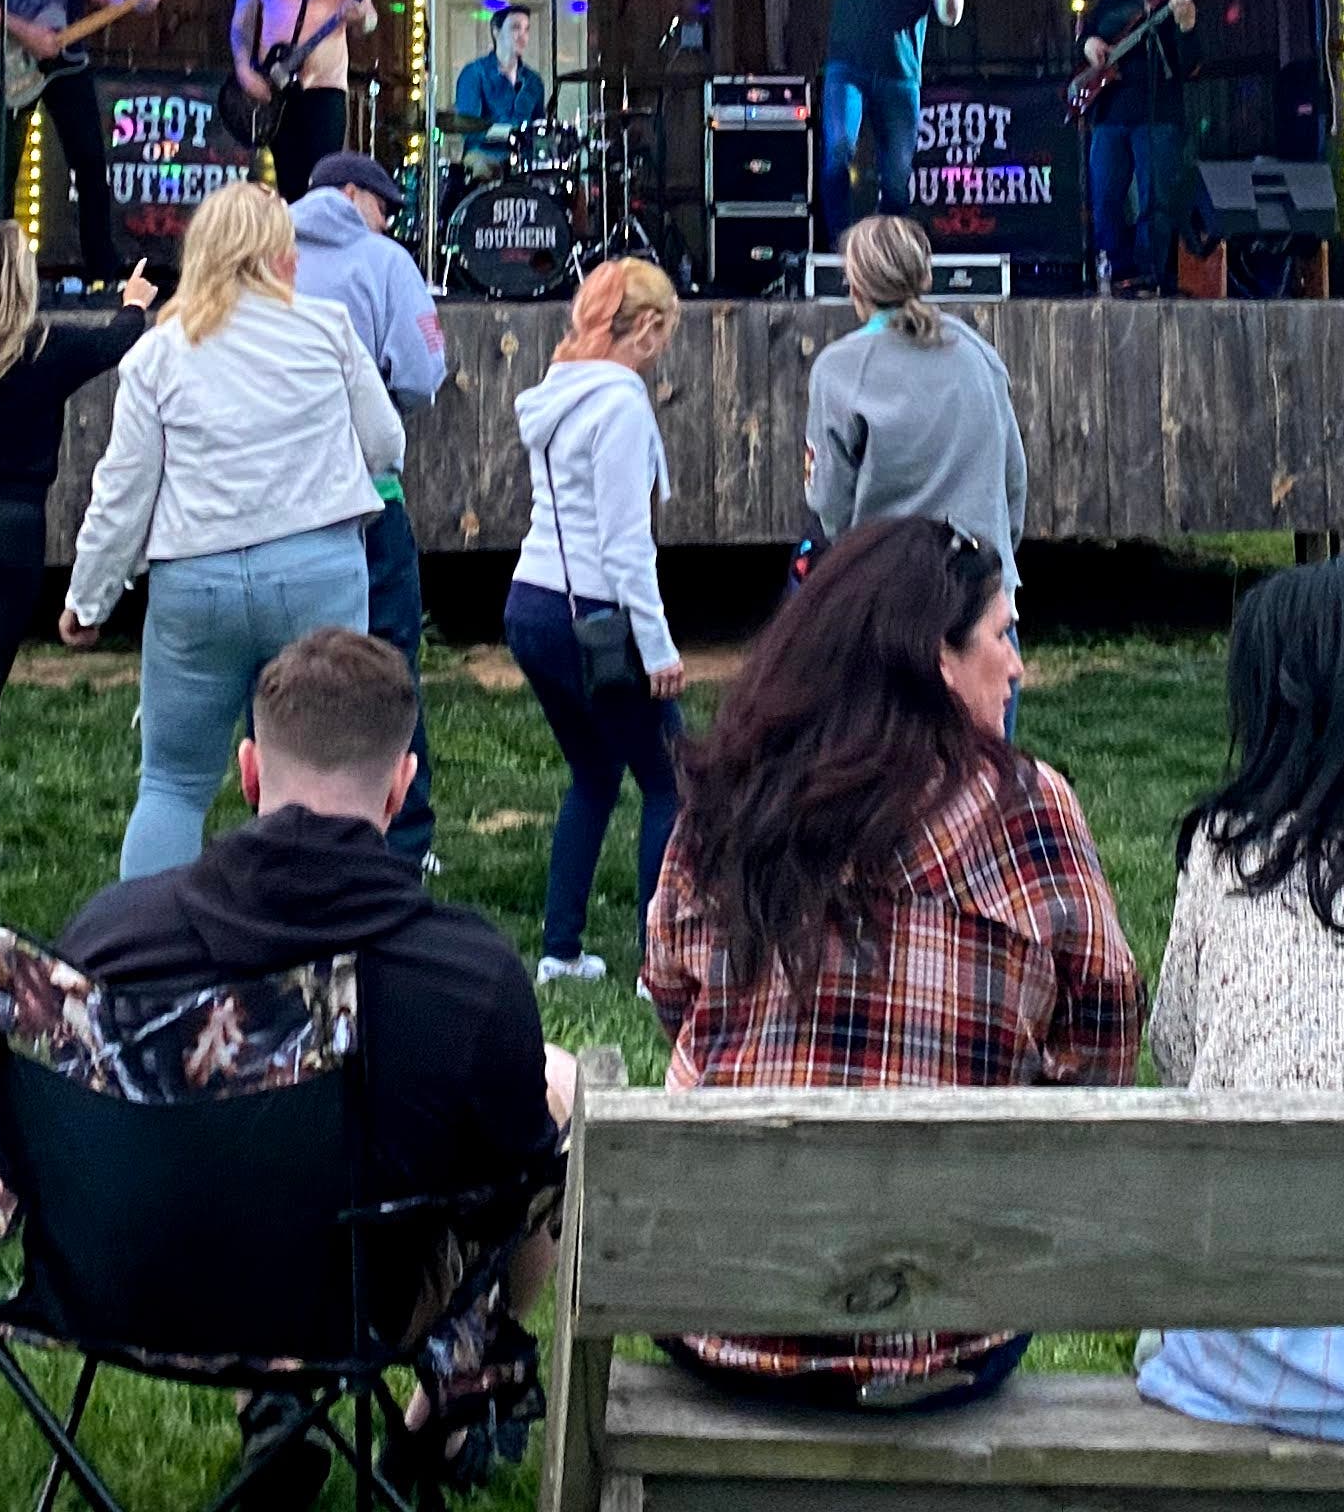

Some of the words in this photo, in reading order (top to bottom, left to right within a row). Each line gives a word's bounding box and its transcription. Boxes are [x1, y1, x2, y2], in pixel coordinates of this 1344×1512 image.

[111, 96, 212, 148] SHOT
[916, 102, 1011, 152] SHOT
[143, 141, 180, 162] OF
[946, 143, 981, 164] OF
[68, 162, 250, 204] UTHER
[908, 165, 1052, 206] UTHERN
[493, 197, 538, 224] SHOT
[474, 226, 556, 250] SOUTHERN
